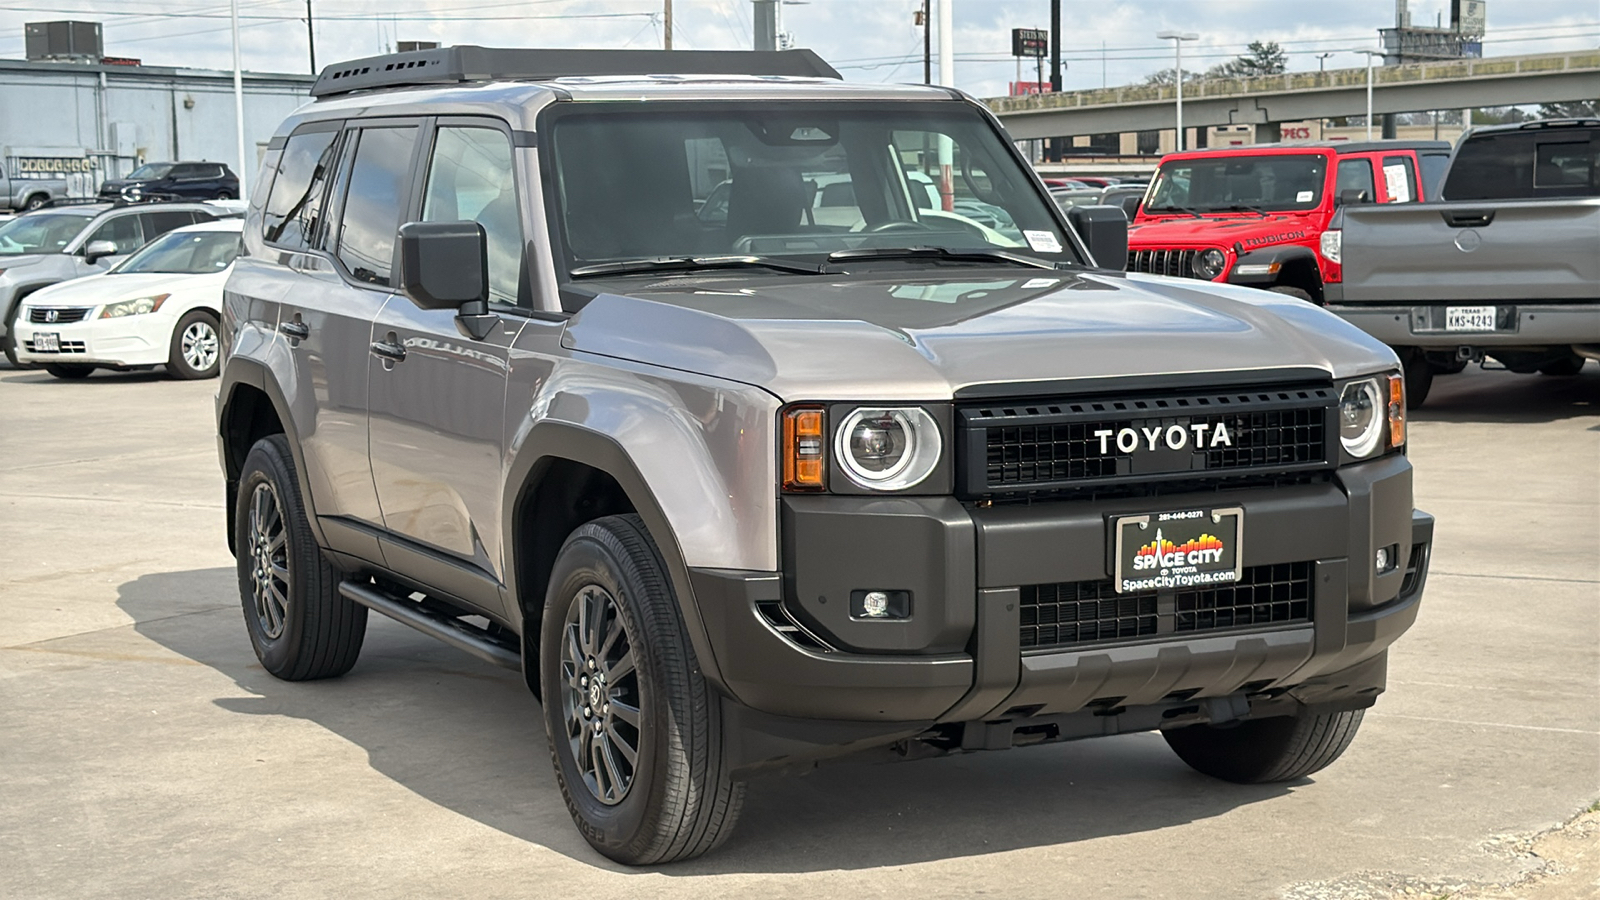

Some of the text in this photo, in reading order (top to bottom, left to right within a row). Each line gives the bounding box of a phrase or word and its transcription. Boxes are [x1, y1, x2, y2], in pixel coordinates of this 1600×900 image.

[1019, 30, 1047, 41] STETSNS
[1245, 230, 1305, 246] RUBICON
[1094, 422, 1232, 454] TOYOTA
[1133, 547, 1224, 570] SPACE CITY
[1171, 565, 1197, 575] TOYOTA
[1122, 570, 1236, 592] SpaceCityToyota.com
